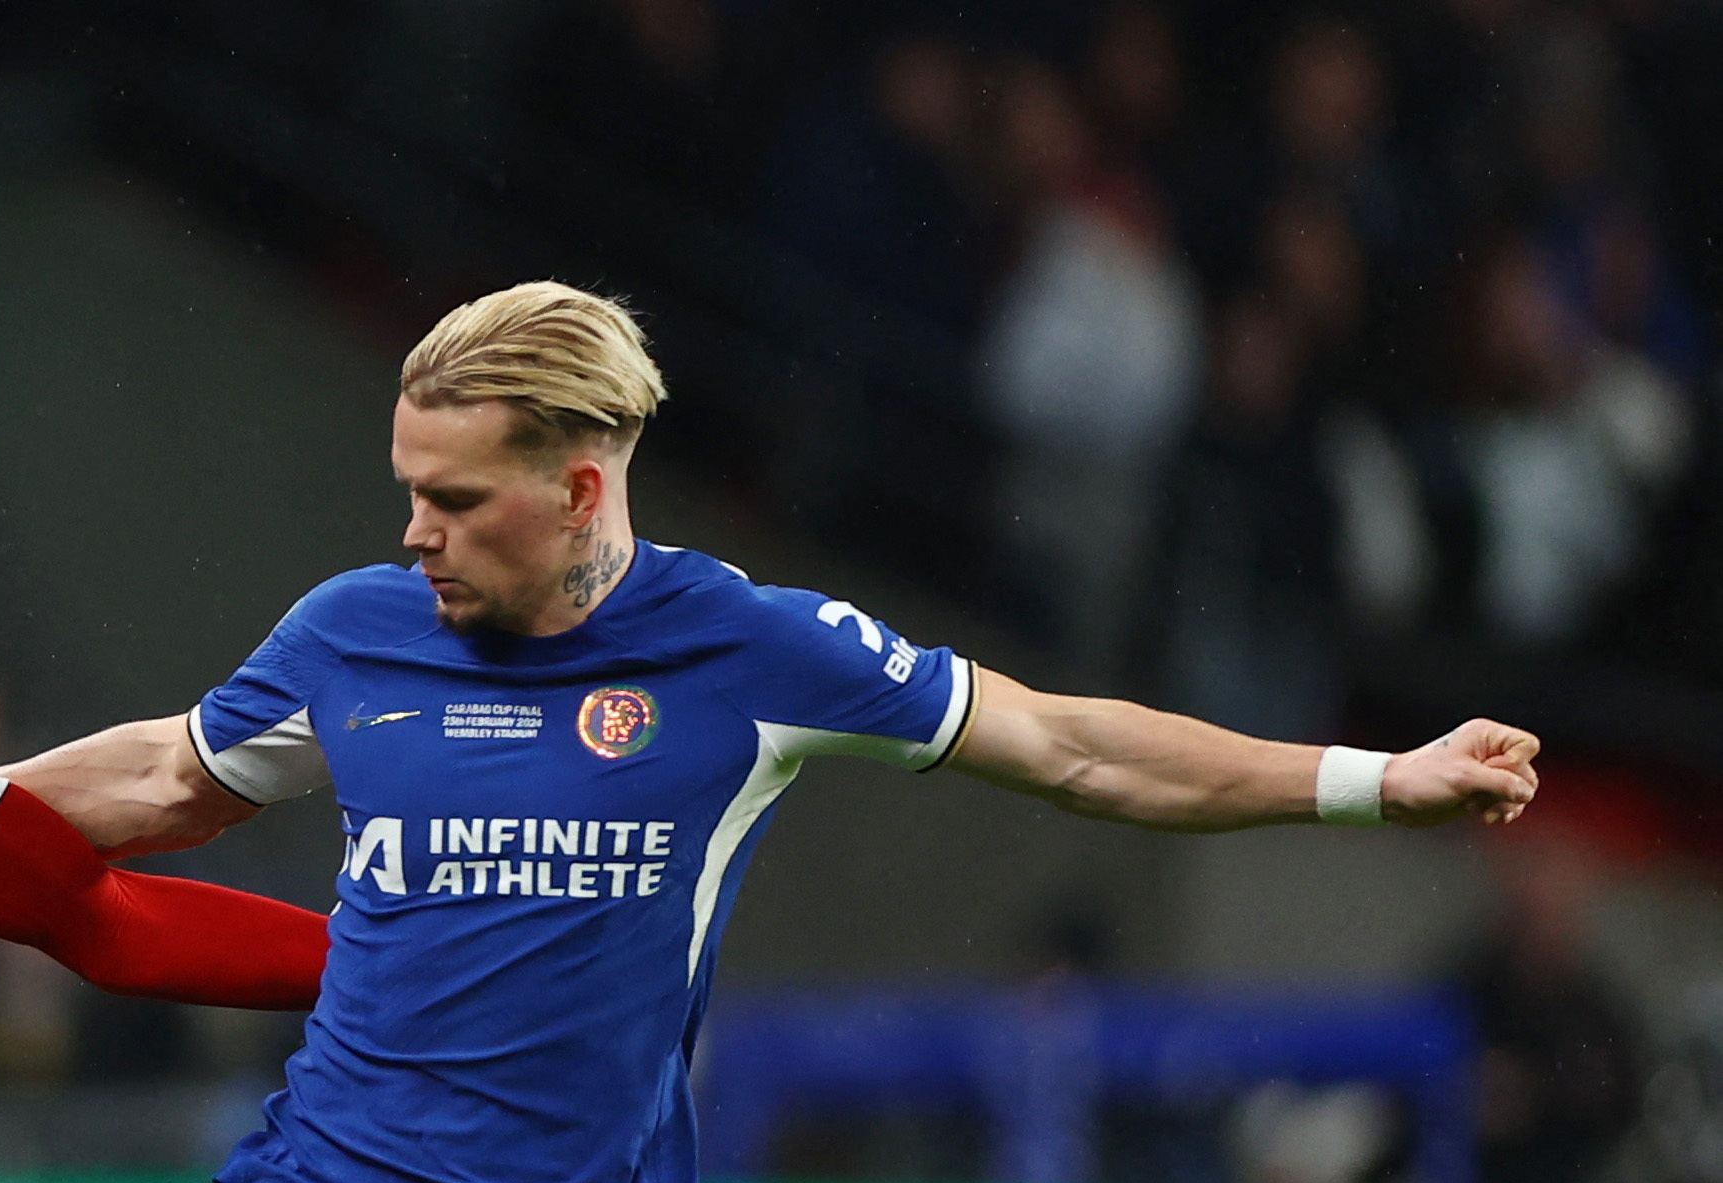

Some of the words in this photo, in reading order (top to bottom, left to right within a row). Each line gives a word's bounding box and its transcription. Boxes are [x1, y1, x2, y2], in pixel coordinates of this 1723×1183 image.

[445, 703, 491, 715] CARABAO
[492, 704, 513, 715] CUP
[513, 705, 543, 717] FINAL
[465, 716, 516, 727] FEBRUARY
[444, 727, 493, 738] WEMBLEY
[429, 818, 675, 856] INFINITE
[427, 860, 667, 898] ATHLETE
